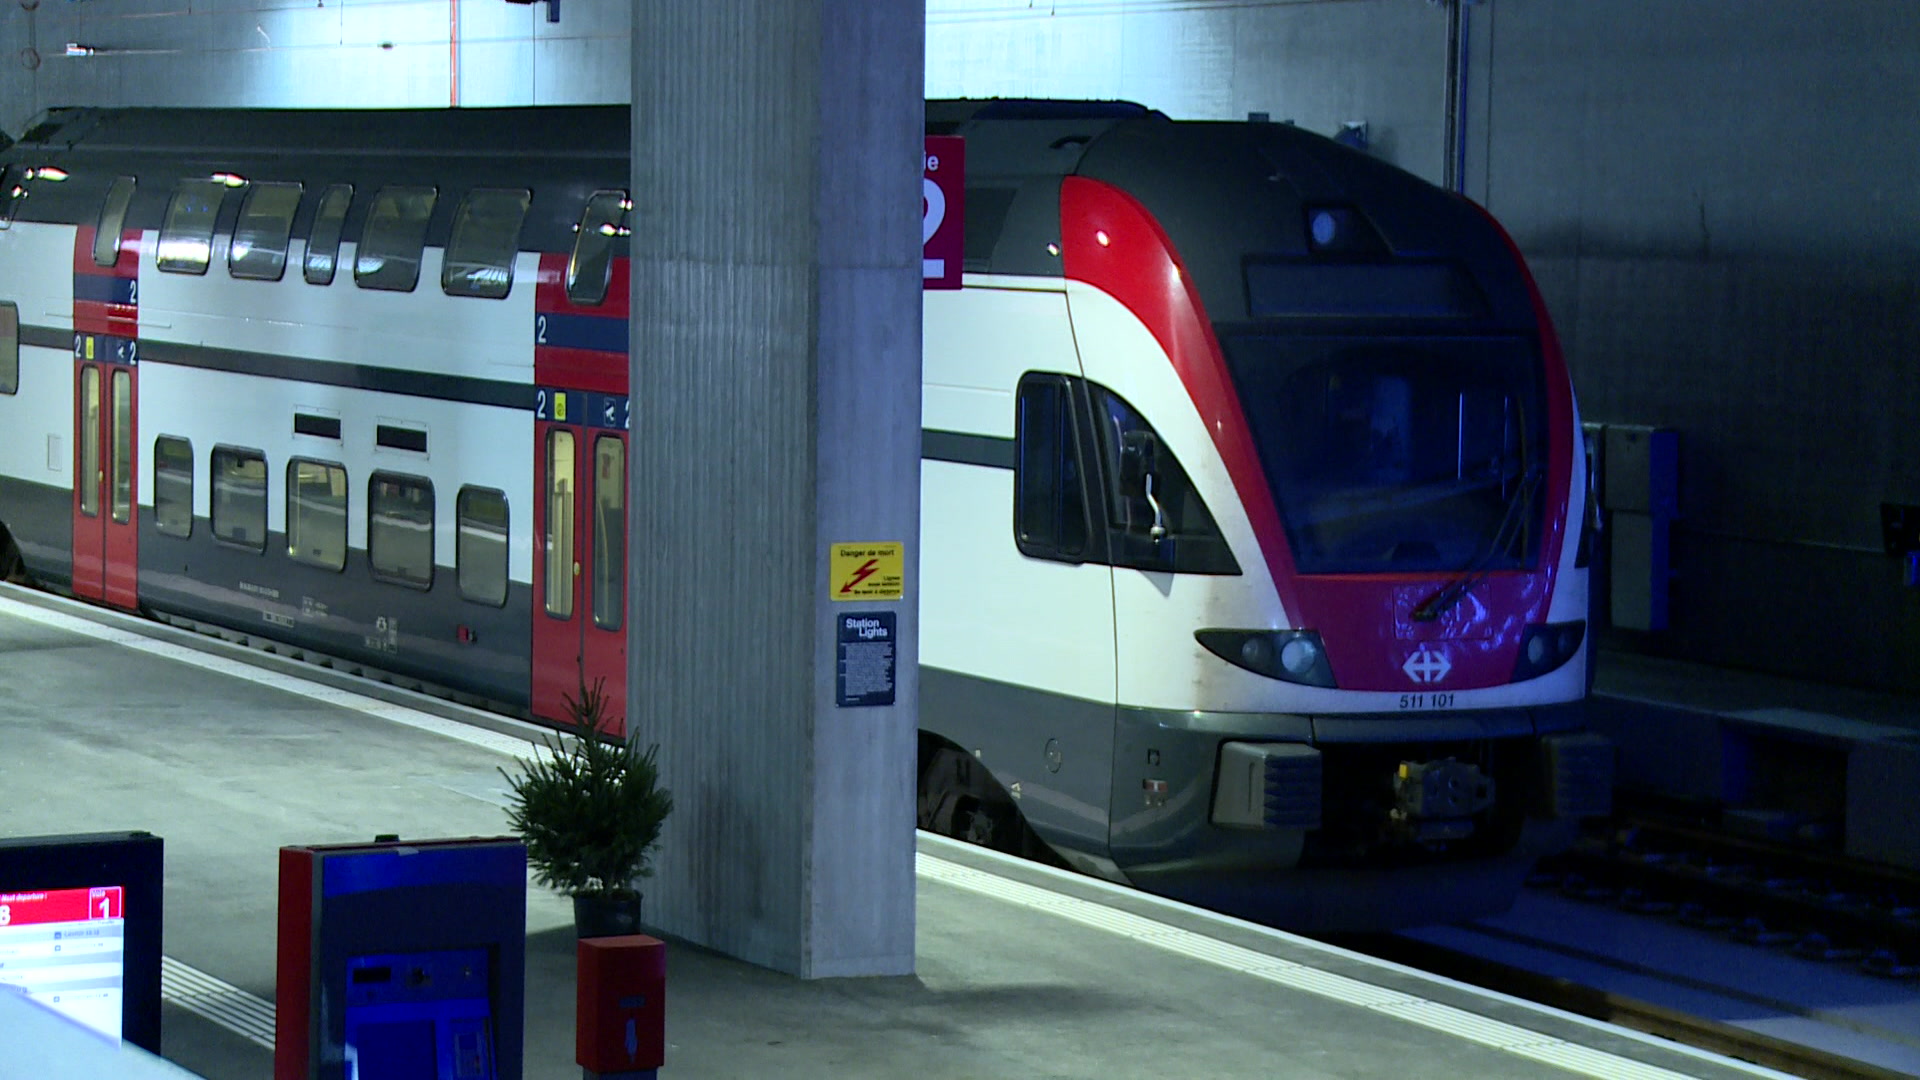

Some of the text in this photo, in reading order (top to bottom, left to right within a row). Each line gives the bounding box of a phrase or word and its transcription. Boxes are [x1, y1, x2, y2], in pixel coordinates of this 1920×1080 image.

[923, 177, 946, 278] 2
[130, 280, 137, 304] 2
[538, 315, 547, 343] 2
[75, 334, 82, 358] 2
[130, 341, 137, 366] 2
[537, 390, 546, 419] 2
[840, 549, 866, 558] Danger
[845, 617, 880, 629] Station
[859, 627, 888, 639] Lights
[1400, 693, 1454, 708] 511 101
[99, 897, 110, 919] 1
